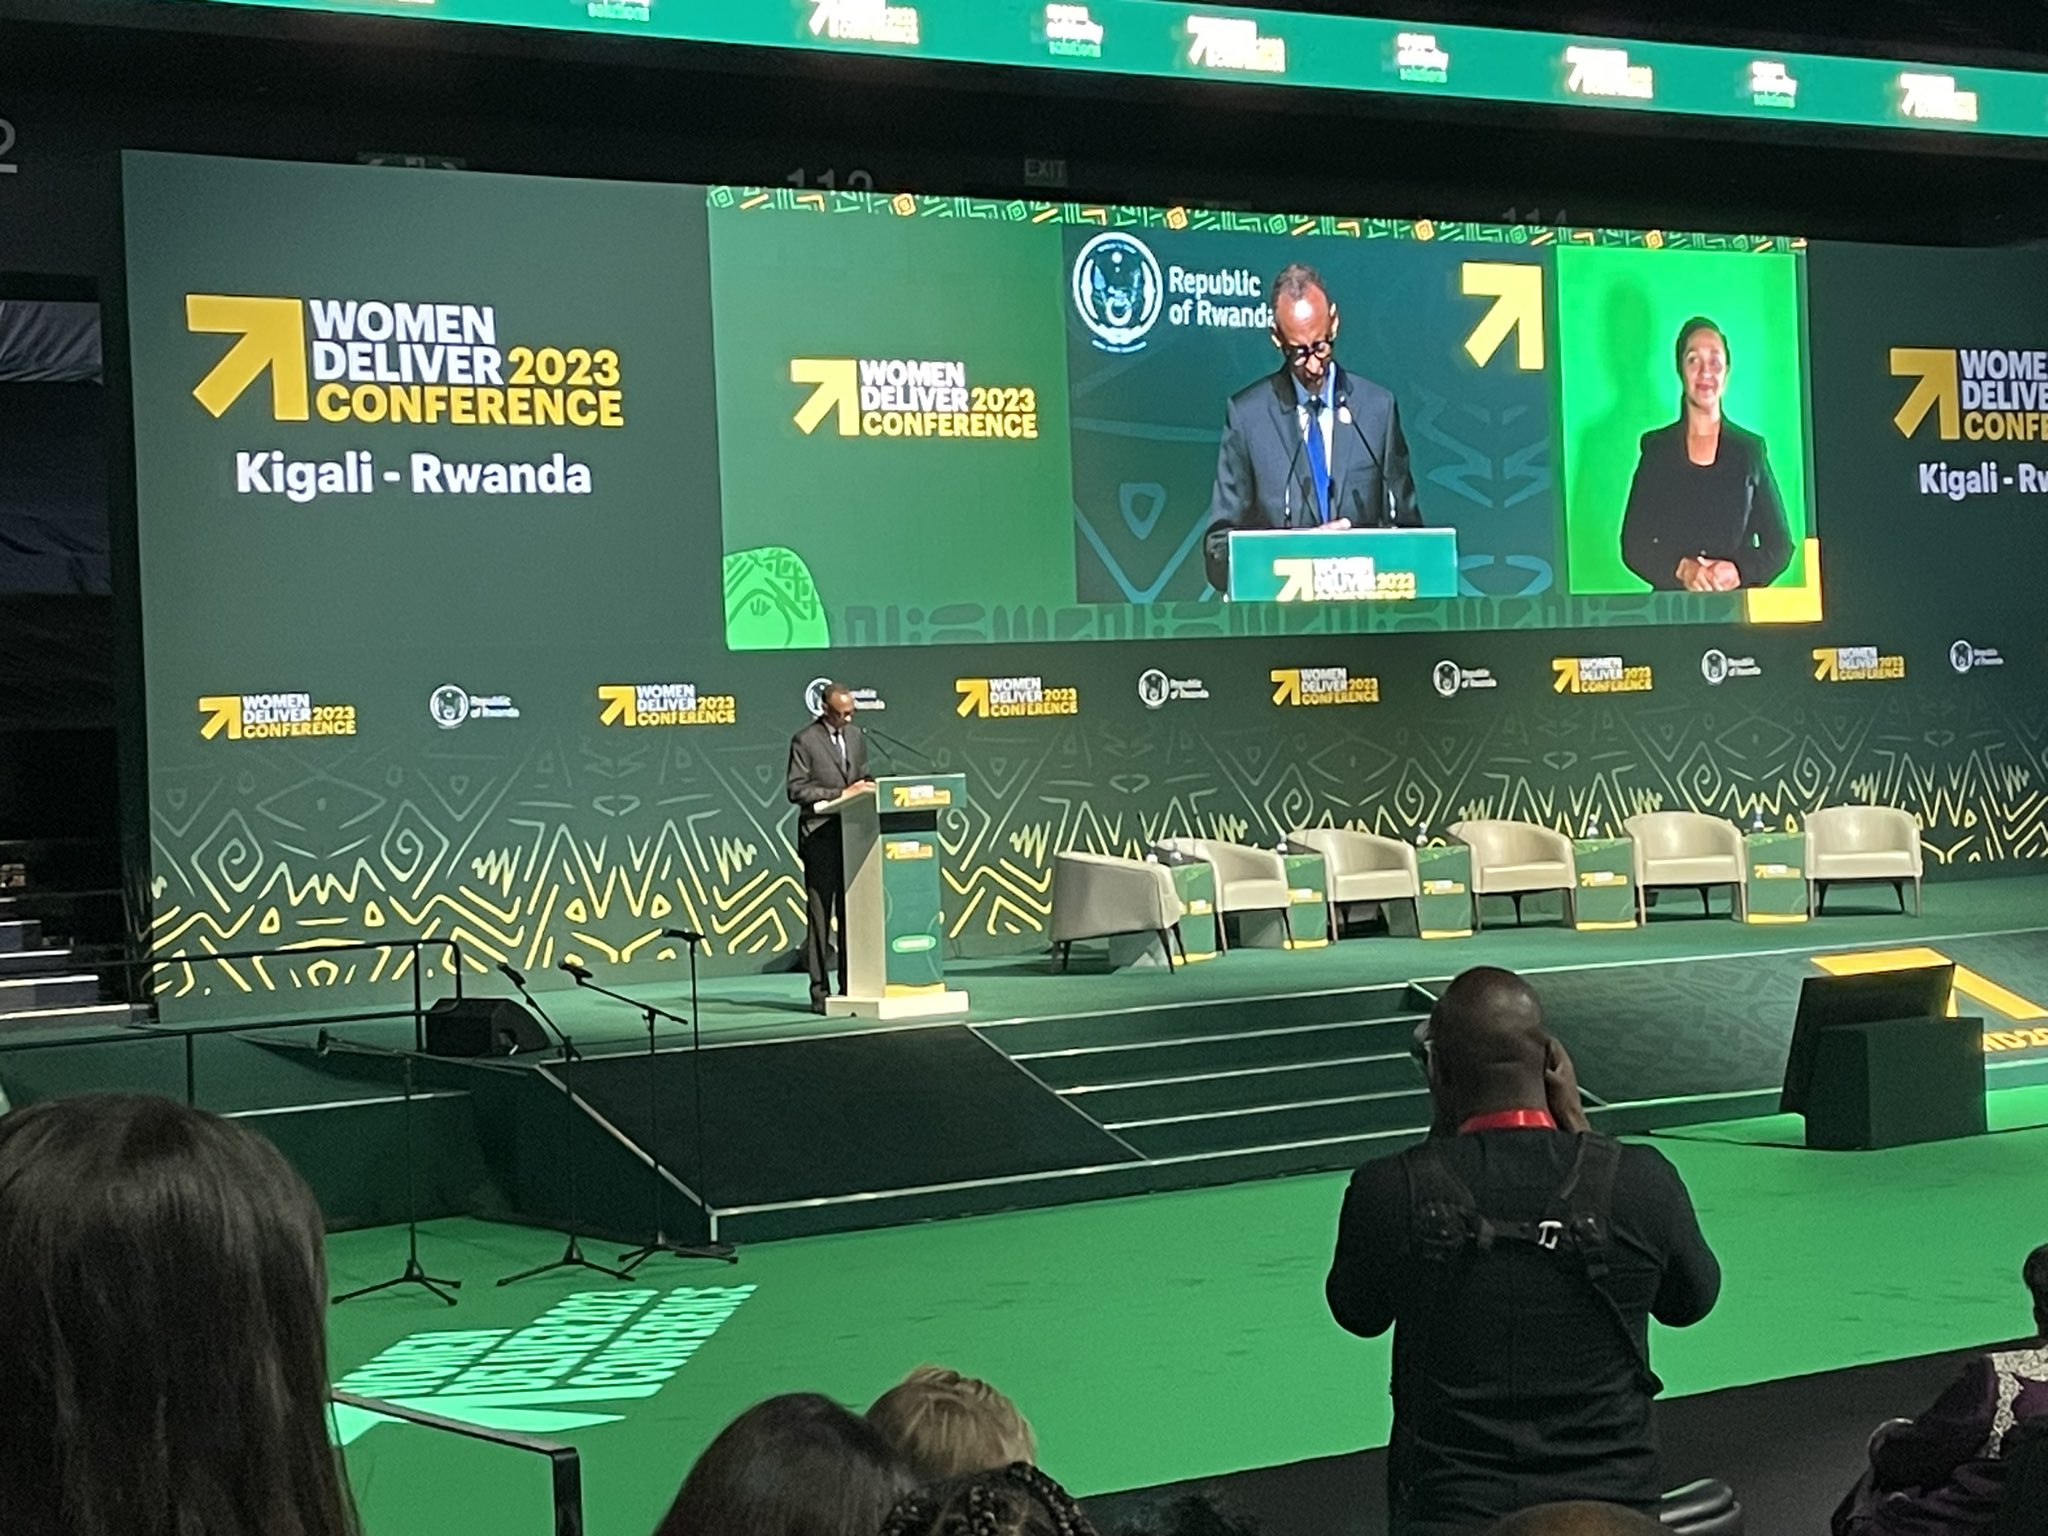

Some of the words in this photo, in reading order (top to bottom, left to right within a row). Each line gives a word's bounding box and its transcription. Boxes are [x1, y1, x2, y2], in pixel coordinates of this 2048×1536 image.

[1025, 159, 1066, 180] EXIT
[1168, 266, 1261, 300] Republic
[308, 299, 496, 345] WOMEN
[1169, 299, 1194, 326] of
[312, 340, 504, 386] DELIVER
[507, 347, 620, 387] 2023
[859, 359, 966, 388] WOMEN
[315, 383, 624, 427] CONFERENCE
[861, 385, 970, 412] DELIVER
[970, 387, 1036, 413] 2023
[862, 411, 1039, 438] CONFERENCE
[236, 451, 373, 503] Kigali
[411, 452, 592, 494] Rwanda
[1919, 462, 1998, 501] Kigali
[636, 684, 695, 699] WOMEN
[989, 677, 1041, 691] WOMEN
[989, 690, 1043, 704] DELIVER
[1043, 688, 1077, 702] 2023
[243, 693, 310, 711] WOMEN
[243, 708, 311, 724] DELIVER
[312, 706, 355, 721] 2023
[636, 698, 697, 713] DELIVER
[697, 696, 735, 711] 2023
[243, 720, 357, 739] CONFERENCE
[637, 710, 736, 726] CONFERENCE
[565, 1284, 758, 1386] CONFERENCE
[434, 1323, 622, 1394] DELIVER
